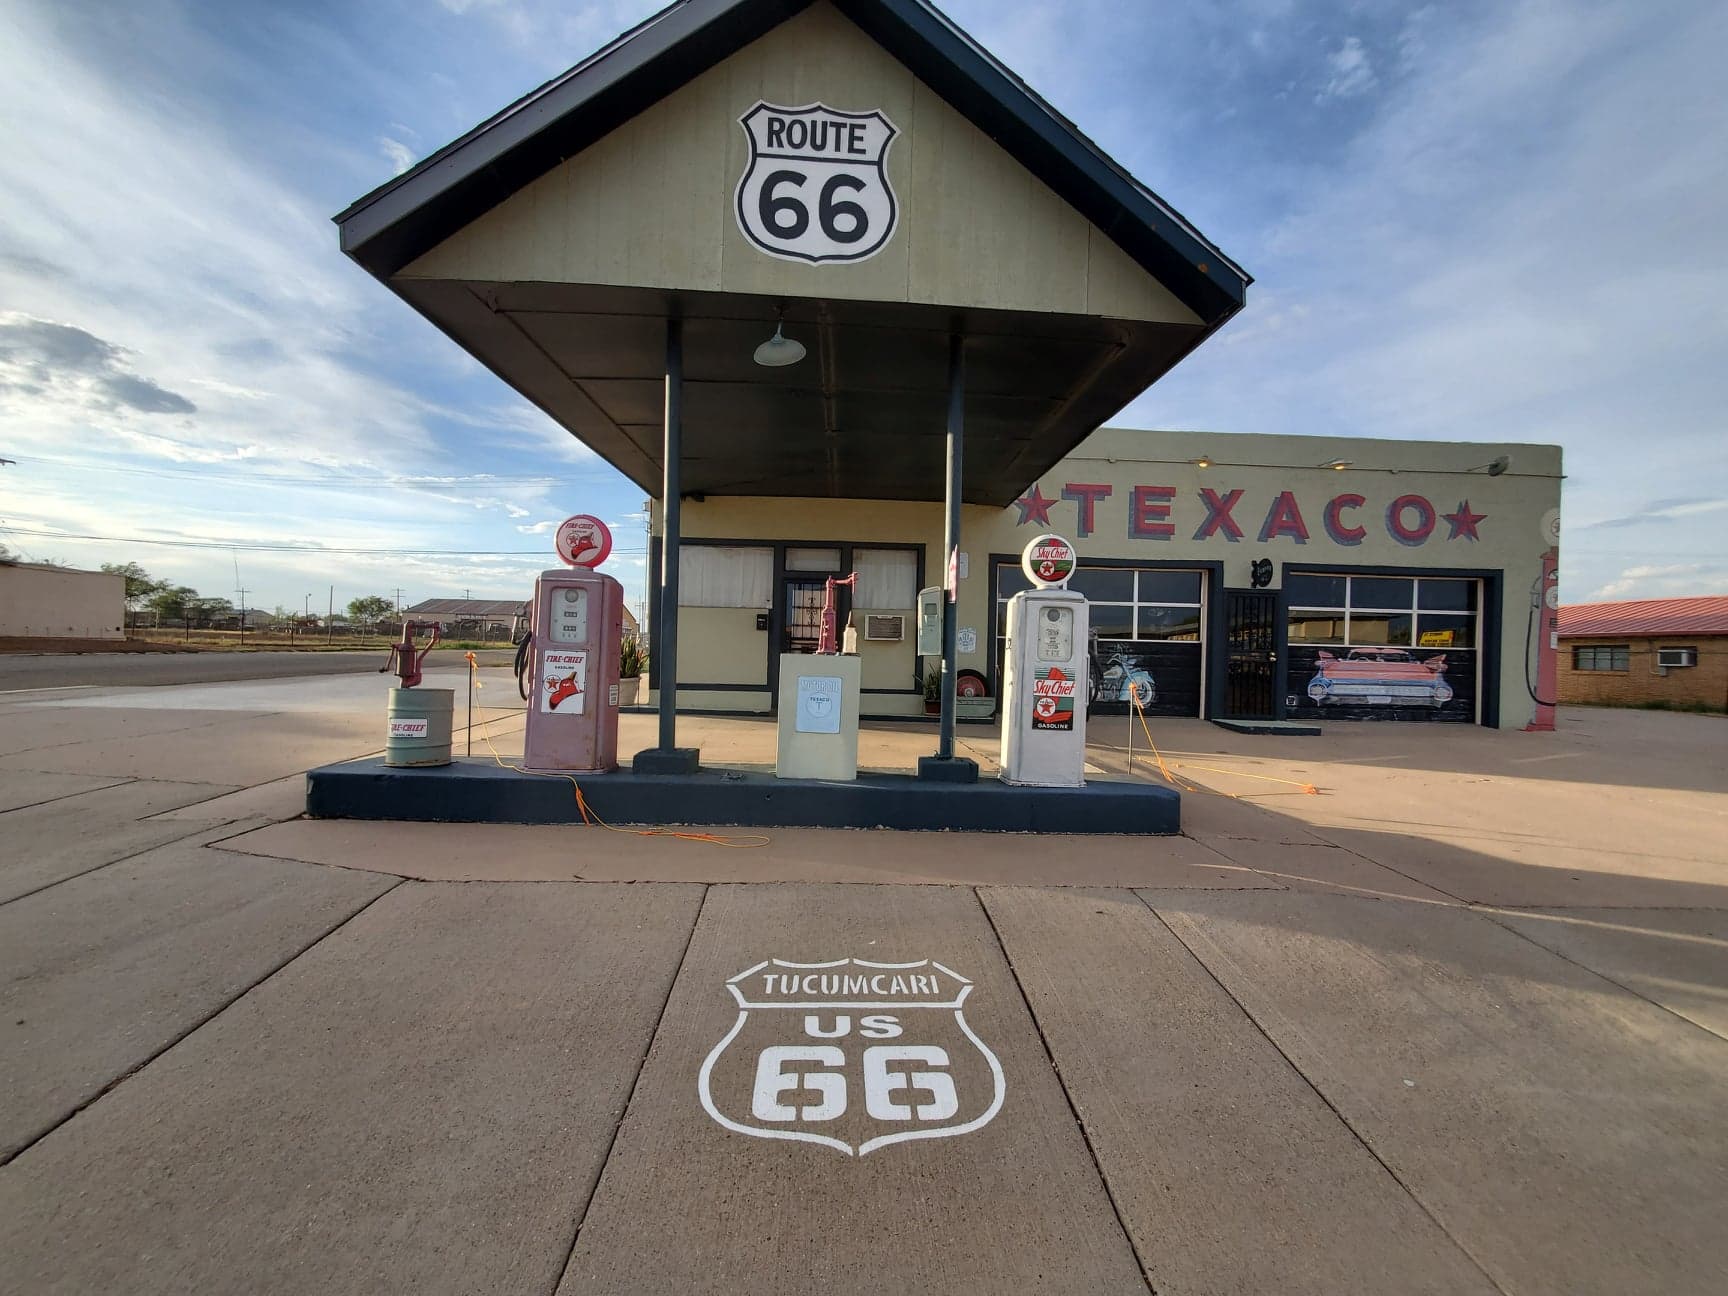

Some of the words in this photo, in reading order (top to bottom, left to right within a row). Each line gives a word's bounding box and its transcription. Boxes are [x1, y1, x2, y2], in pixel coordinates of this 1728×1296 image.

[767, 116, 867, 155] ROUTE
[758, 169, 869, 244] 66
[1062, 482, 1437, 546] TEXACO
[1037, 547, 1050, 559] Sky
[1050, 547, 1069, 559] Chief
[546, 655, 584, 664] FIRE-CHIEF
[1033, 680, 1050, 697] Sky
[1051, 680, 1076, 695] Chief
[762, 974, 940, 995] TUCUMCARI
[804, 1015, 903, 1039] US
[752, 1045, 959, 1122] 66
